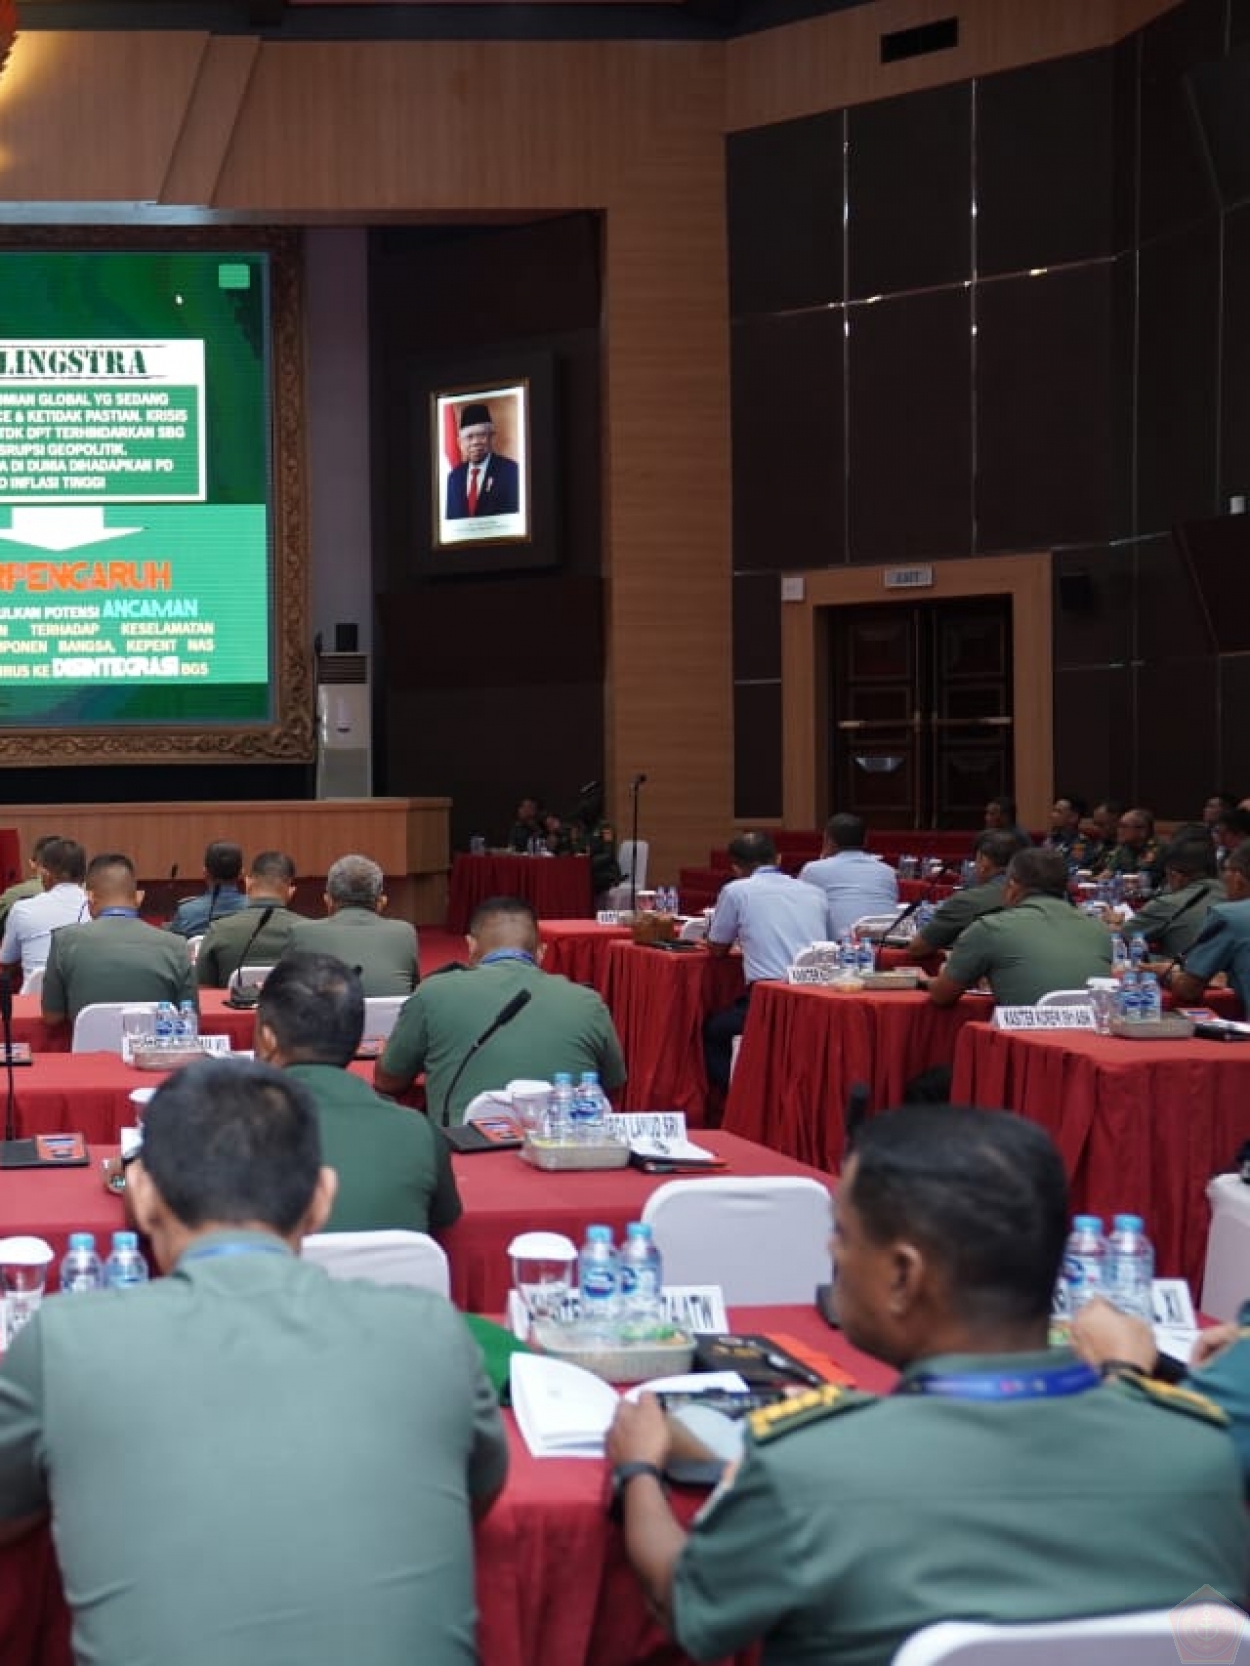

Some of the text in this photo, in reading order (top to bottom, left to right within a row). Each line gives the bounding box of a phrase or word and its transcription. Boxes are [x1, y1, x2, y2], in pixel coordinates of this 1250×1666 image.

[94, 392, 113, 405] YG
[115, 392, 170, 405] SEDANG
[14, 411, 25, 422] &
[27, 410, 83, 422] KETIDAK
[146, 409, 189, 421] KRISIS
[27, 426, 53, 440] DPT
[55, 426, 155, 439] TERHINDARKAN
[157, 425, 186, 438] SBG
[11, 460, 25, 473] DI
[27, 459, 67, 473] DUNIA
[69, 459, 153, 472] DIHADAPKAN
[155, 458, 175, 472] PD
[10, 476, 60, 489] INFLASI
[62, 476, 107, 489] TINGGI
[44, 606, 100, 620] POTENSI
[102, 599, 199, 618] ANCAMAN
[30, 623, 100, 637] TERHADAP
[120, 622, 215, 636] KESELAMATAN
[125, 639, 177, 653] KEPENT
[186, 638, 215, 653] NAS
[32, 665, 51, 678] KE
[51, 656, 180, 678] DISINTEGRASI
